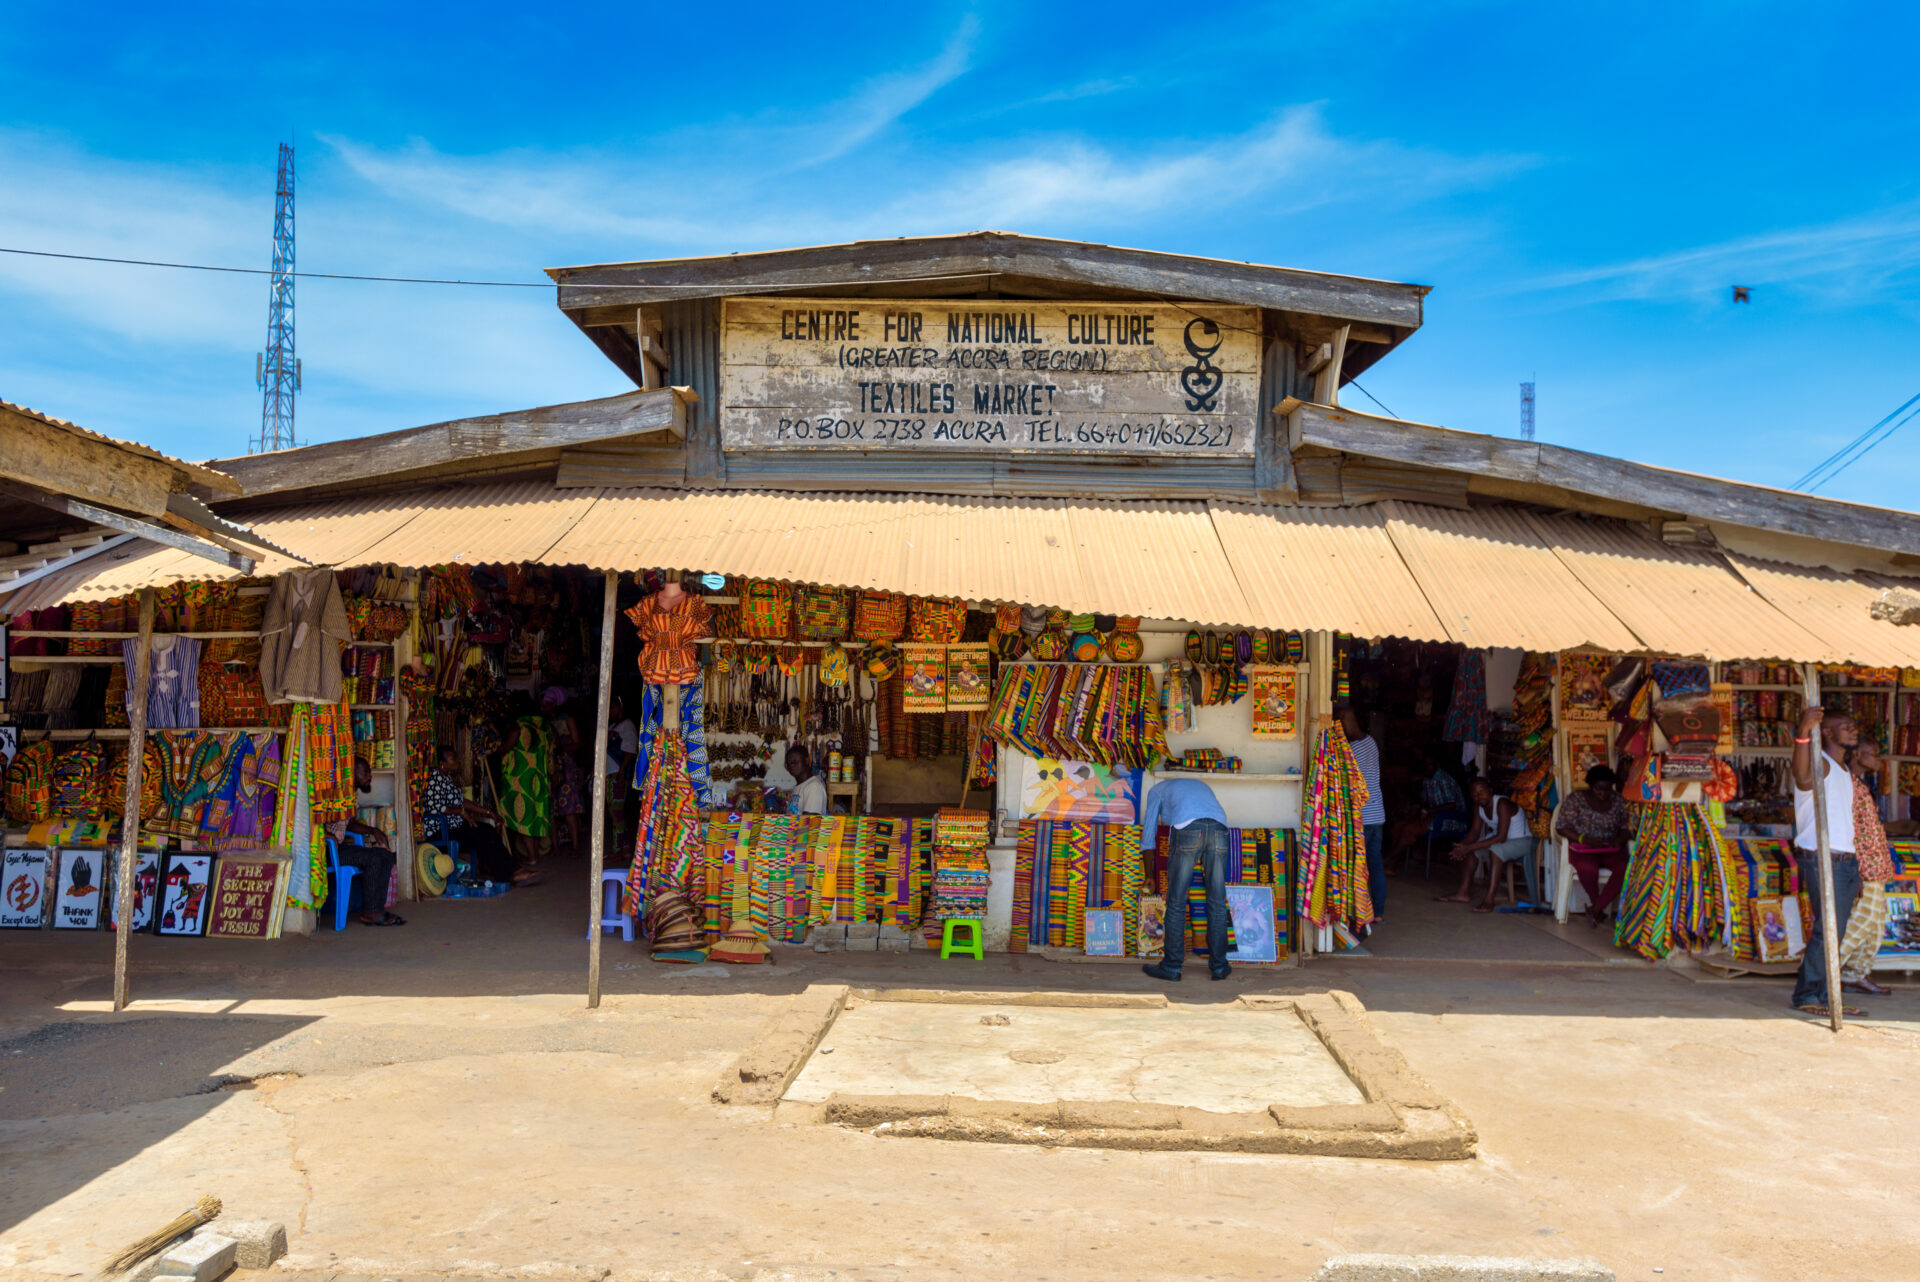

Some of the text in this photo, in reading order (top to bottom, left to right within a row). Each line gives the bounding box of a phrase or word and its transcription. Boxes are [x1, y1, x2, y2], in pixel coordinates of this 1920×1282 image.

[781, 309, 1155, 346] CENTRE FOR NATIONAL CULTURE
[839, 344, 1108, 371] (GREATER ACCRA REGION)
[857, 382, 1057, 416] TEXTILES MARKET
[873, 418, 926, 440] 2738
[933, 419, 1007, 443] ACCRA
[906, 652, 944, 662] GREETINGS
[1565, 709, 1608, 721] WELCOME
[1160, 836, 1170, 857] FROM
[236, 865, 264, 878] THE
[222, 878, 273, 893] SECRET
[222, 892, 266, 907] OF MY
[62, 906, 94, 917] THANK
[220, 906, 264, 920] JOY IS
[2, 915, 39, 927] Except God
[69, 917, 88, 925] YOU
[219, 920, 260, 935] JESUS
